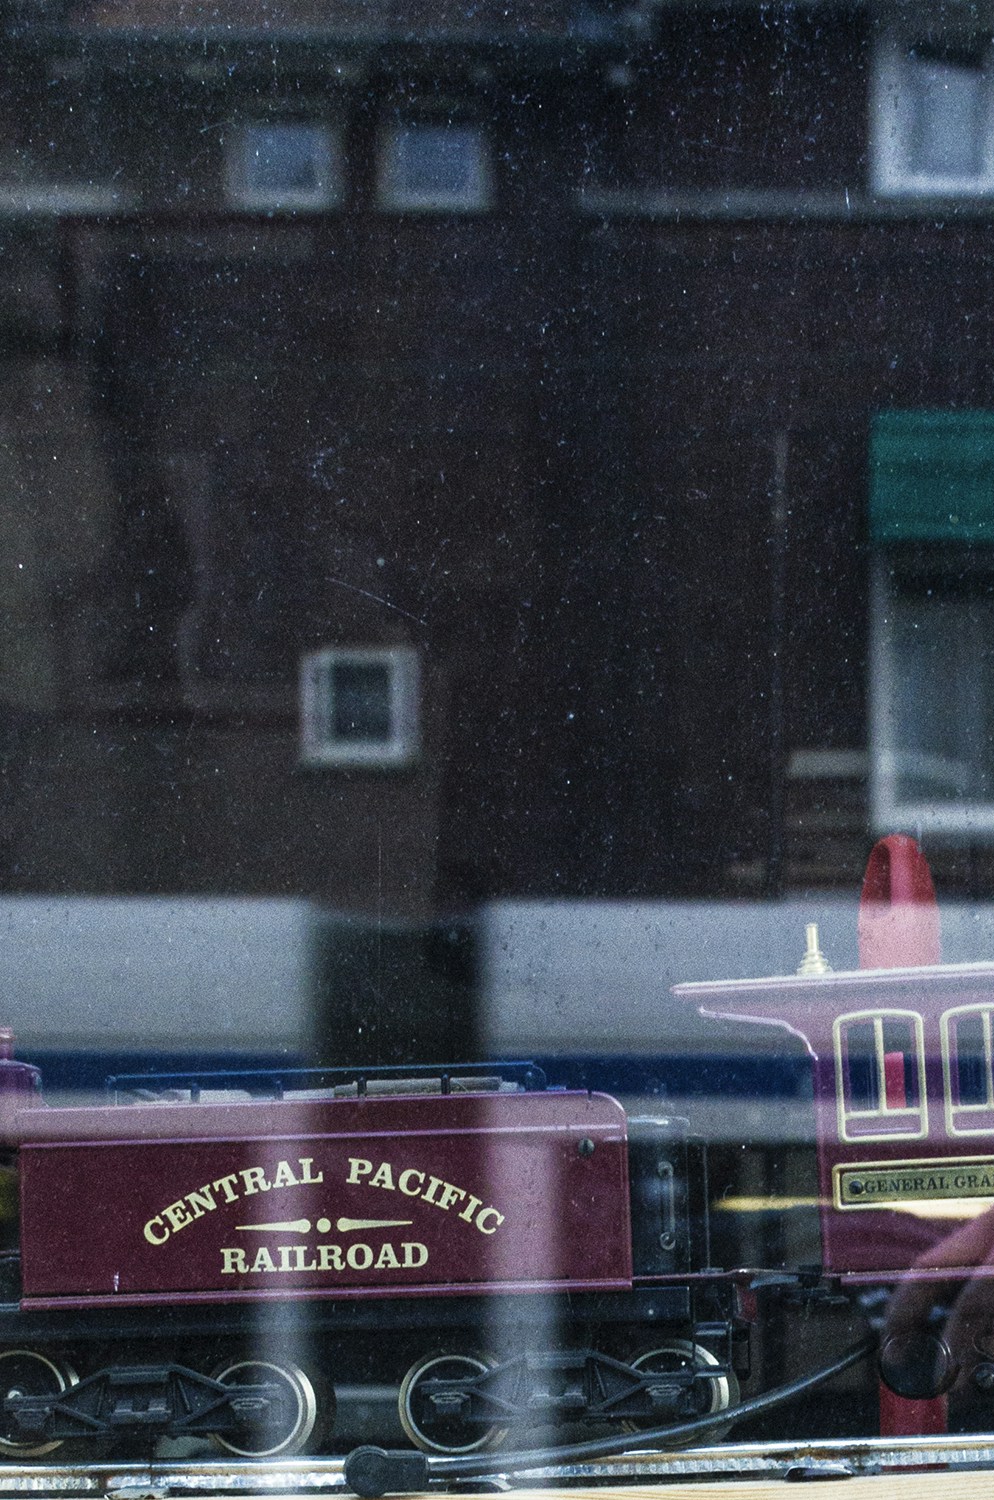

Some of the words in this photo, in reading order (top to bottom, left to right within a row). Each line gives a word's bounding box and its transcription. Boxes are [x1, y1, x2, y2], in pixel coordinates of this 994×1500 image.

[863, 1176, 950, 1194] GENERAL
[143, 1157, 324, 1246] CENTRAL
[346, 1157, 505, 1235] PACIFIC
[220, 1242, 429, 1274] RAILROAD
